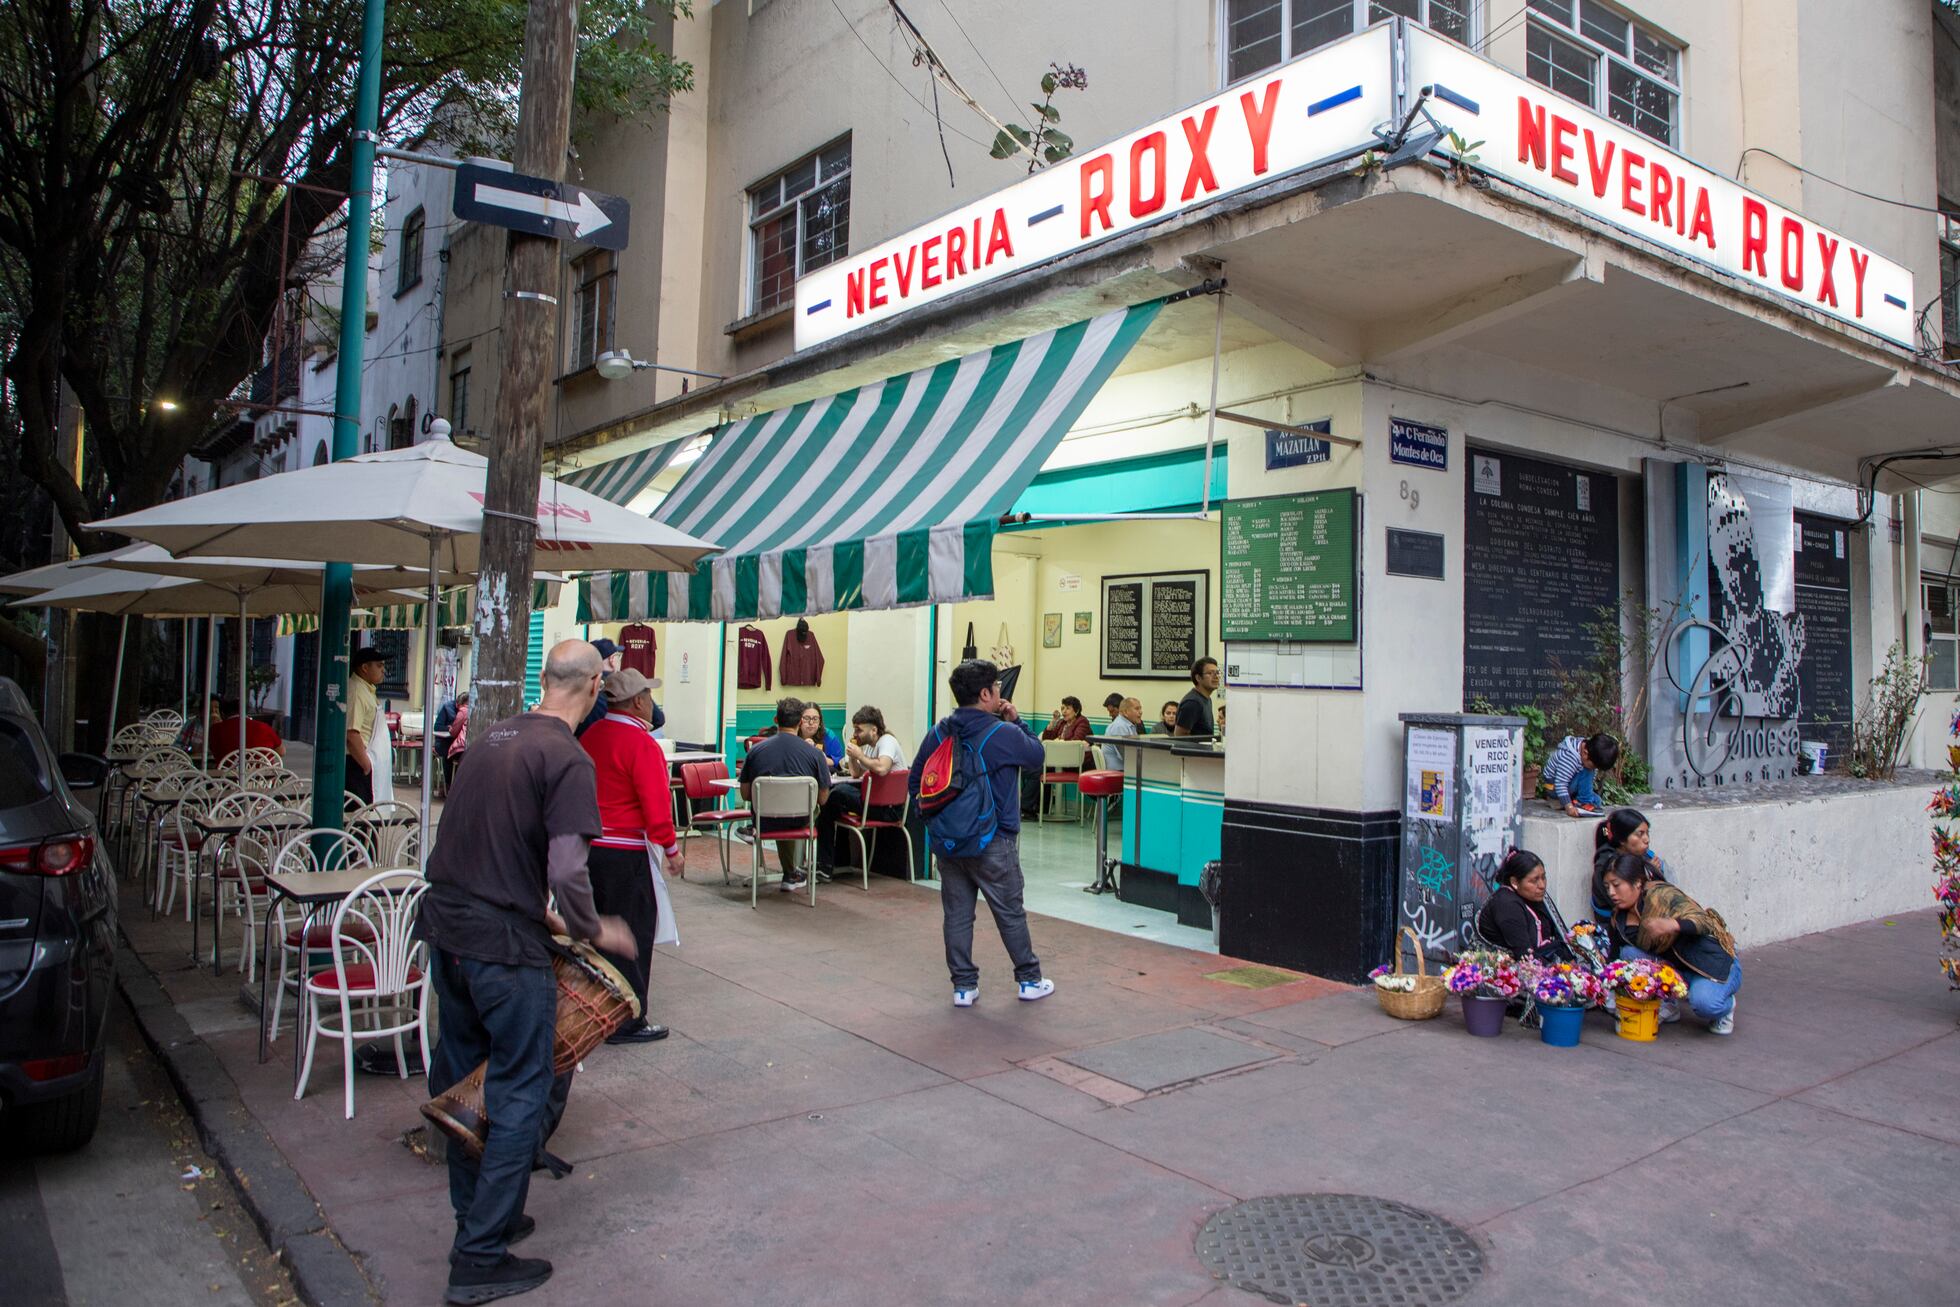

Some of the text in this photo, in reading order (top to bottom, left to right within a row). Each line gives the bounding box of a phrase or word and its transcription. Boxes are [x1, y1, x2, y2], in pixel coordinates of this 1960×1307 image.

[847, 79, 1282, 318] NEVERIA ROXY
[1518, 96, 1869, 317] NEVERIA ROXY
[1413, 427, 1445, 446] Fernando
[1393, 442, 1444, 464] Montes de Oca
[1400, 480, 1419, 510] 89
[1517, 503, 1540, 514] CONDESA
[1544, 509, 1563, 518] CUMPLE
[1568, 512, 1579, 521] CIEN
[1475, 739, 1509, 749] VENENO
[1487, 751, 1509, 760] RICO
[1475, 764, 1509, 774] VENENO
